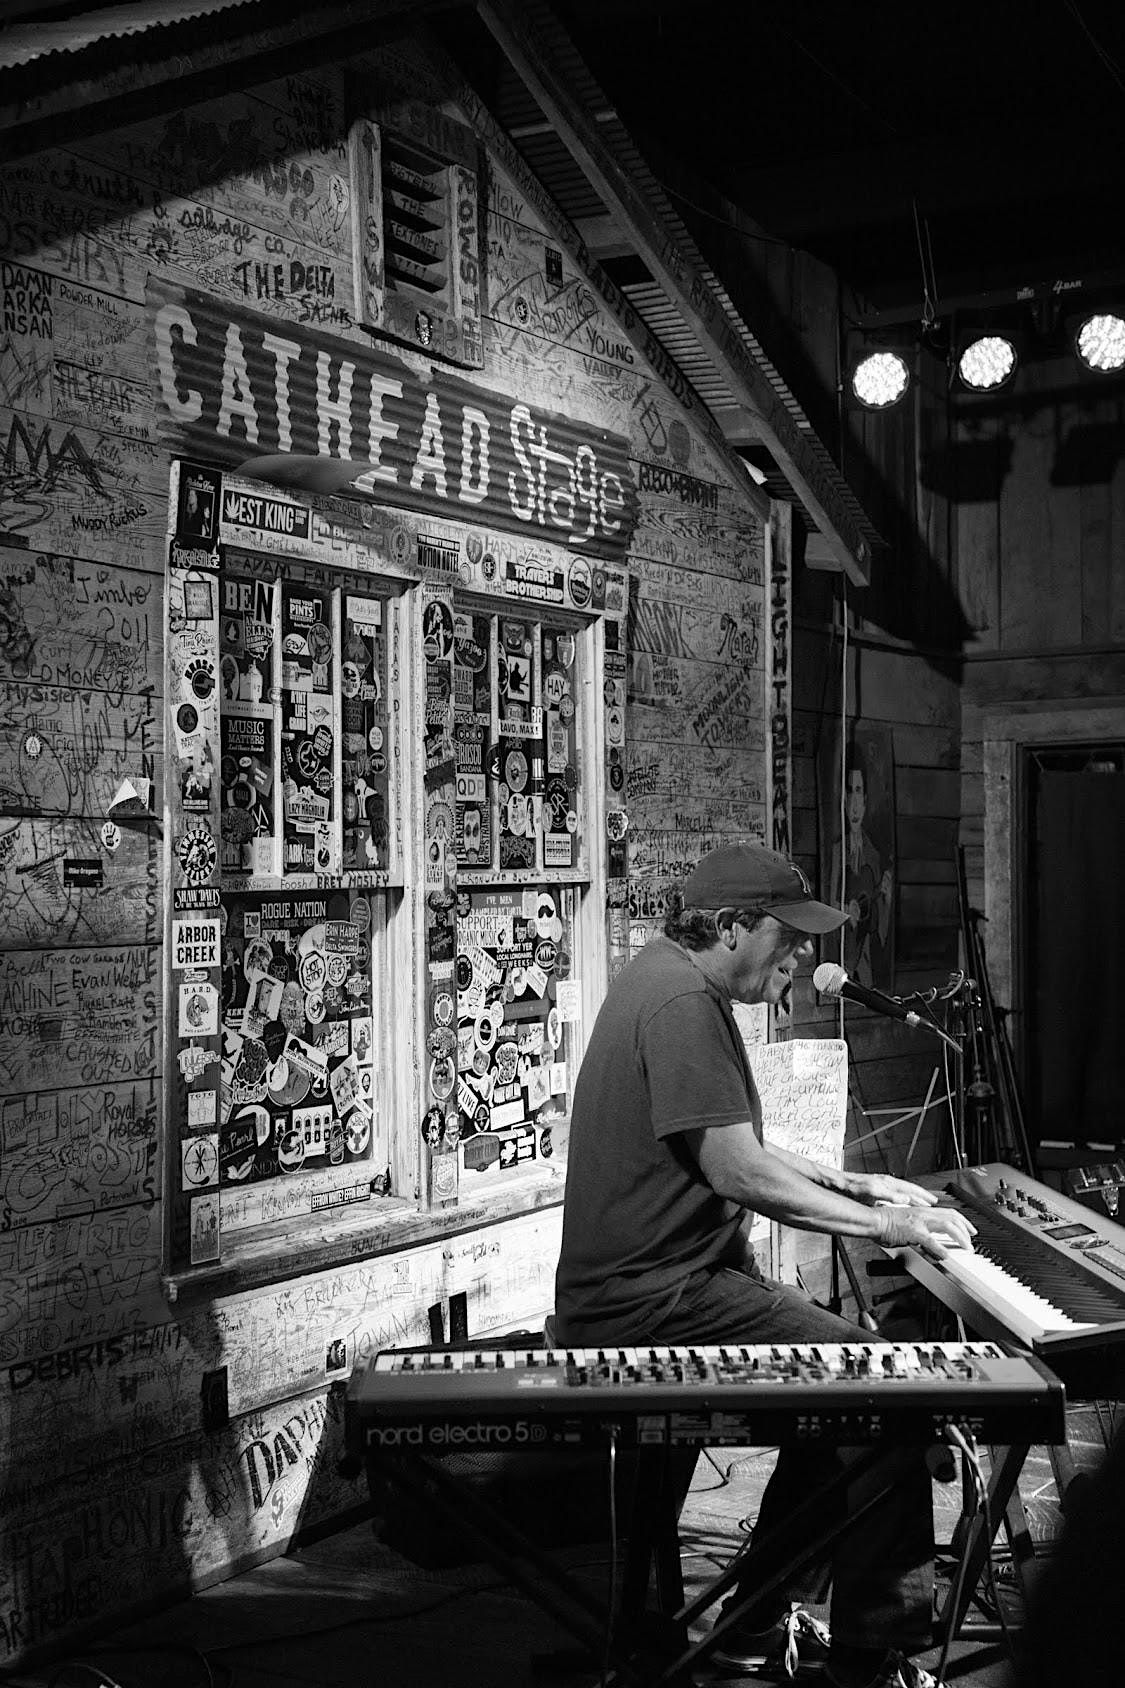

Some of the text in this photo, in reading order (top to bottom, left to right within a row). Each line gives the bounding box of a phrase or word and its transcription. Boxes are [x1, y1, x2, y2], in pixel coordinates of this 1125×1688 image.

[1, 264, 53, 297] DAMN
[235, 260, 335, 300] THE DELTA
[60, 284, 119, 316] POWDER MILL
[585, 327, 634, 365] YOUNG
[154, 302, 491, 505] CATHEAD
[71, 512, 108, 531] MUDDY
[265, 502, 294, 534] KING
[289, 604, 314, 617] PINTS
[228, 719, 265, 735] MUSIC
[228, 734, 265, 746] MATTERS
[458, 778, 485, 796] QDP
[317, 872, 343, 888] BRET
[348, 871, 388, 887] MOSLEY
[175, 888, 220, 909] SHAW DAVIS
[499, 895, 513, 905] BEEN
[261, 900, 327, 920] ROGUE NATION
[177, 926, 216, 945] ARBOR
[326, 924, 339, 936] ERIN
[177, 945, 216, 964] CREEK
[496, 942, 533, 954] SUPPORT YER
[496, 953, 510, 961] LOCAL
[69, 953, 91, 965] COW
[305, 958, 320, 974] HOT
[508, 959, 530, 968] WEEKS
[305, 968, 323, 986] STOP
[183, 986, 211, 995] HARD
[9, 1336, 127, 1390] DEBRIS
[367, 1423, 423, 1447] nord
[429, 1420, 513, 1446] electro
